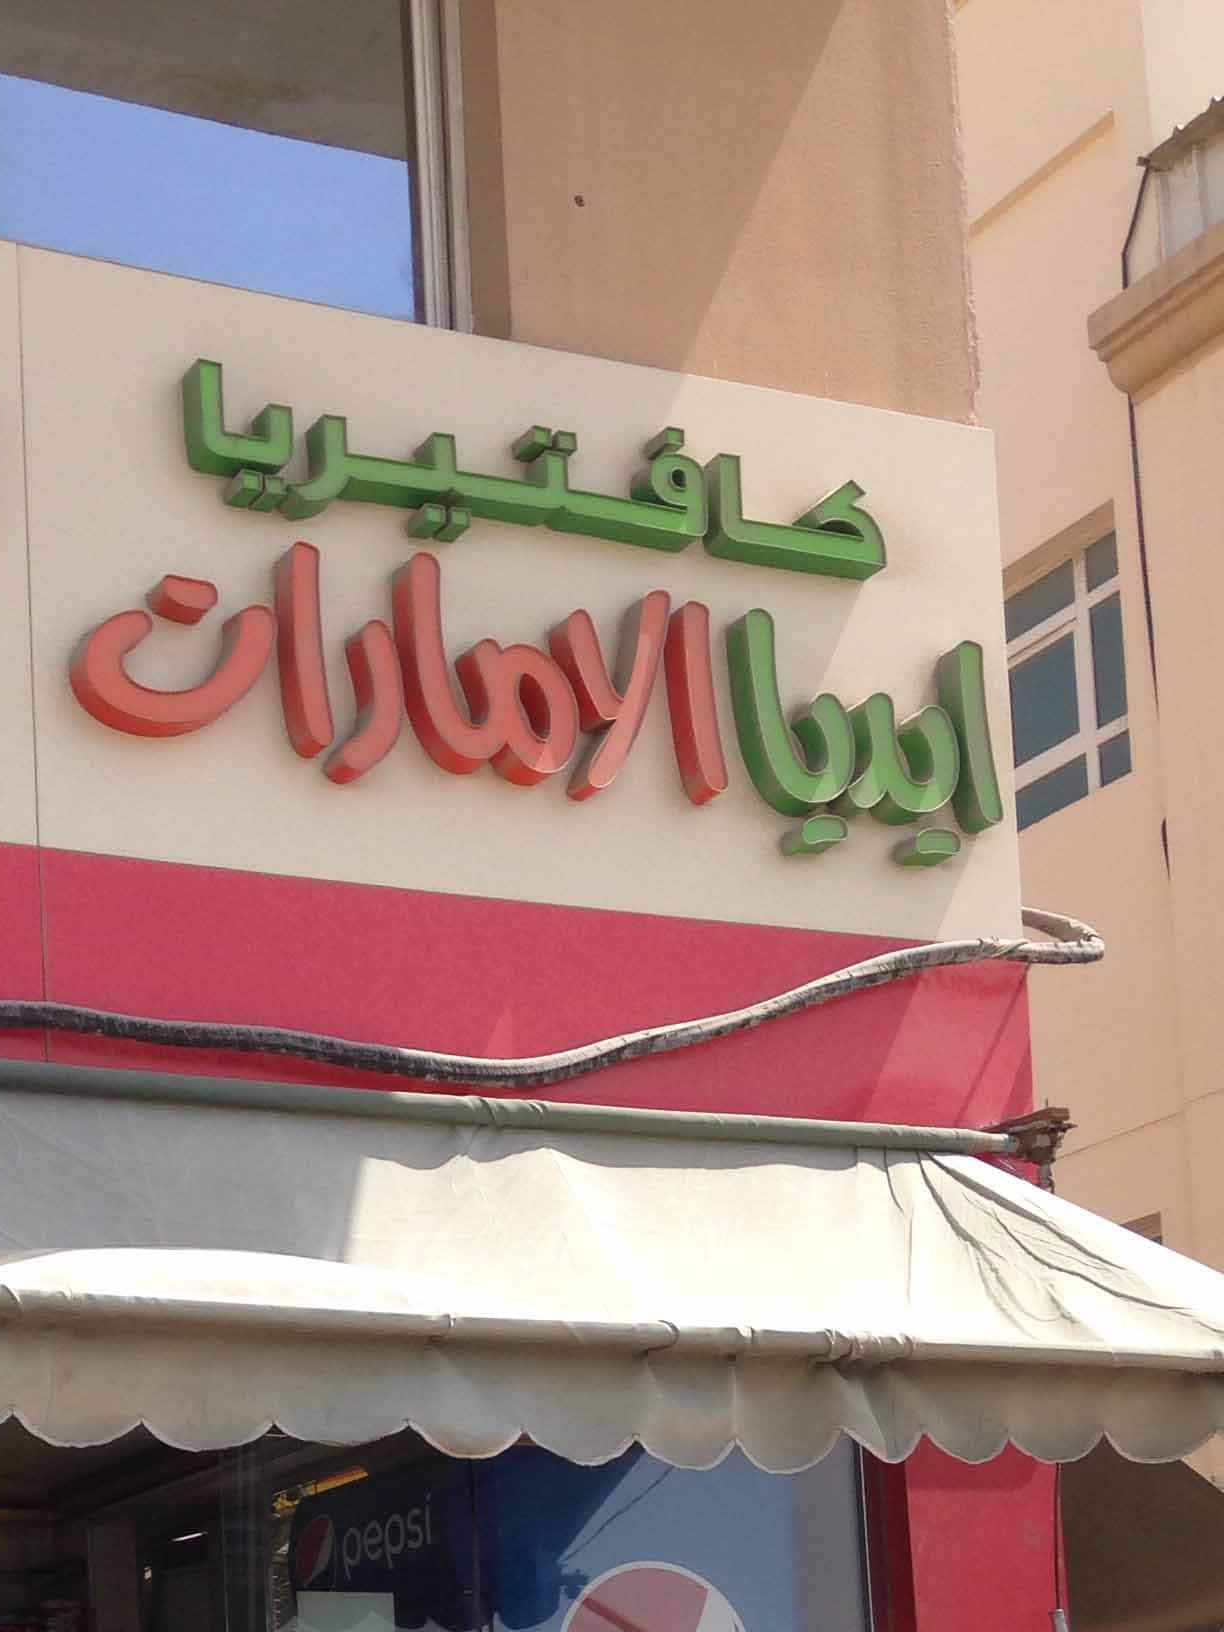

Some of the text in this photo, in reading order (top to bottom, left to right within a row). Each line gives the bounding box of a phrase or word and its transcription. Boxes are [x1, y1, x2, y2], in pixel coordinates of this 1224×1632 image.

[180, 357, 886, 582] كافتيريا
[726, 607, 1005, 868] ايديا
[342, 1490, 433, 1582] pepsi
